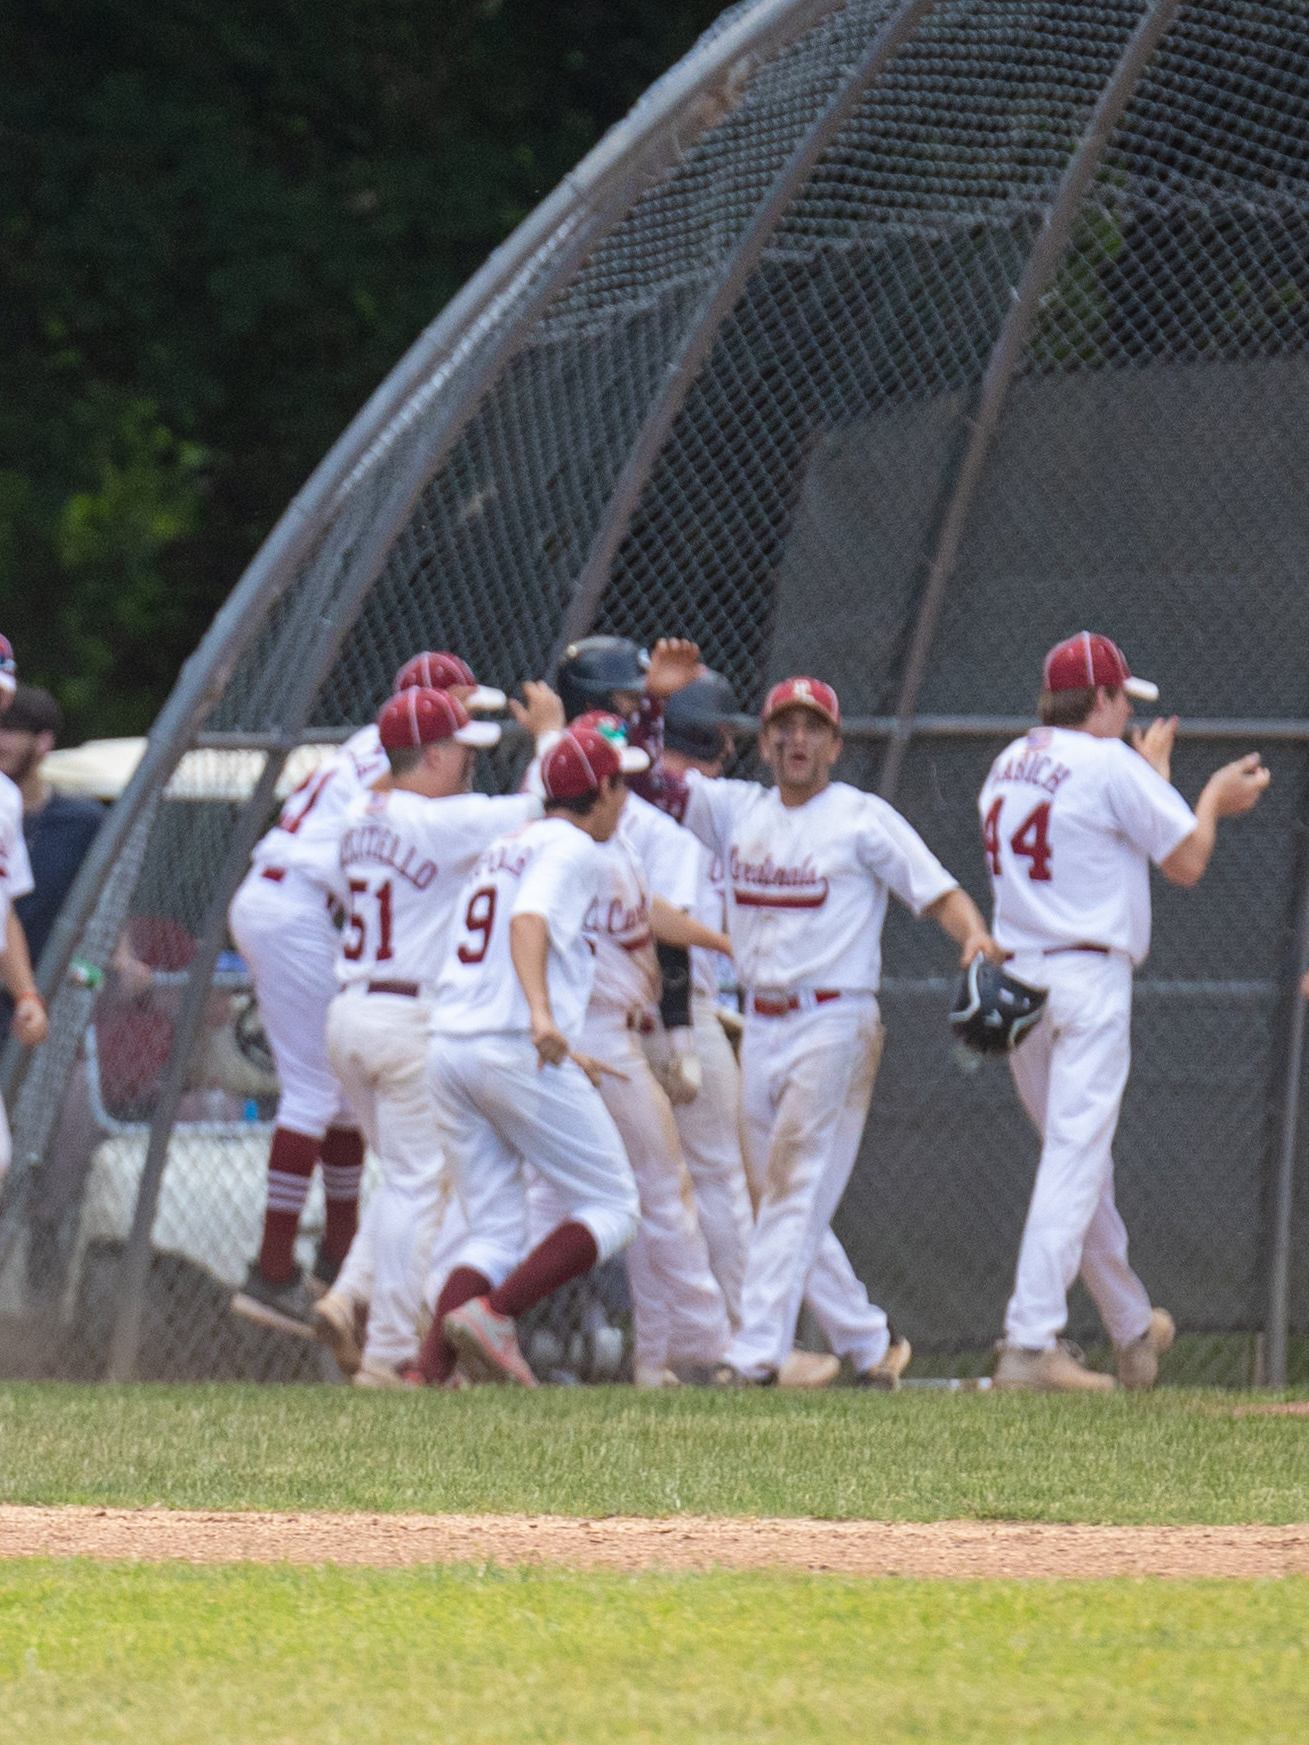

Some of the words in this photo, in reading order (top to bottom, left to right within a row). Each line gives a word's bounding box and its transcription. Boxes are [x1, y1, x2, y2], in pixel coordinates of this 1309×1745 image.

[985, 796, 1052, 881] 44
[344, 878, 393, 961] 51
[457, 885, 497, 964] 9
